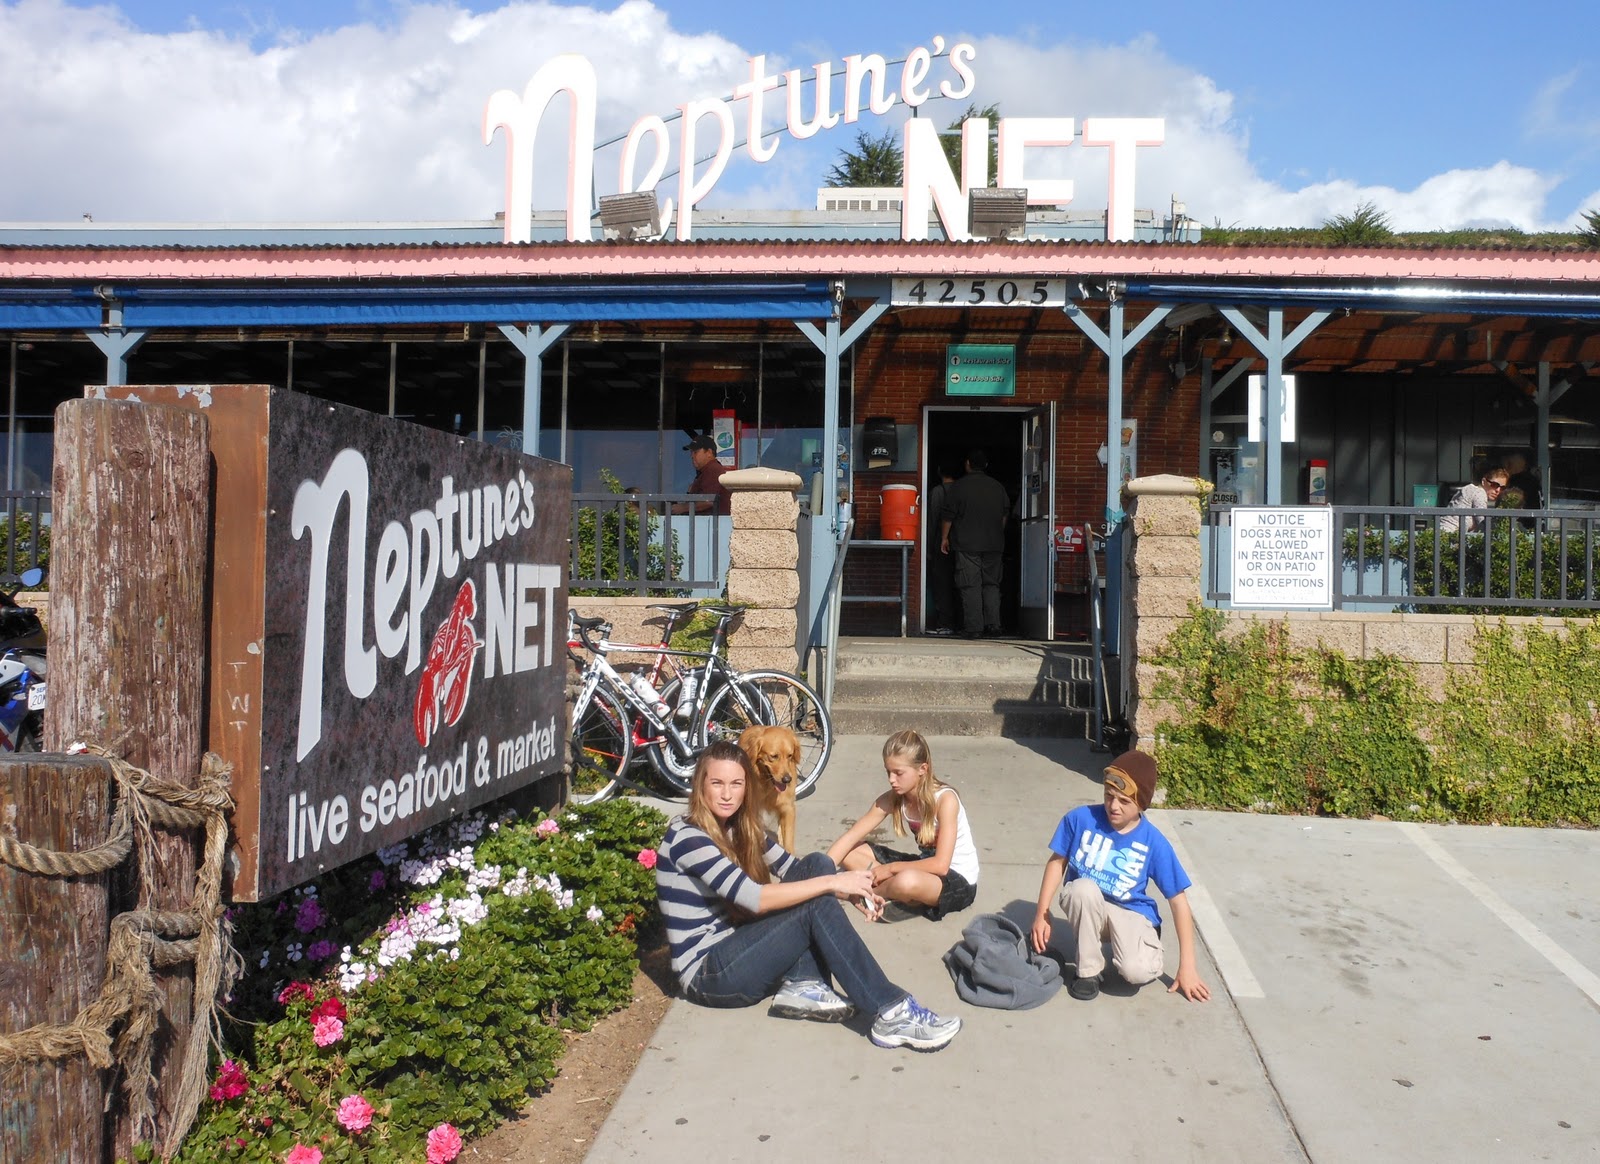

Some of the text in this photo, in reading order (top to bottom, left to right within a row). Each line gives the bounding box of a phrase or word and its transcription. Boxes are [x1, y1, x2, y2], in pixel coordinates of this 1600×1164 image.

[901, 117, 1165, 241] NET
[909, 279, 1048, 305] 42505
[1213, 493, 1238, 504] CLOSED
[1258, 514, 1305, 525] NOTICE
[1240, 529, 1322, 539] DOGS ARE NOT
[1254, 540, 1308, 549] ALLOWED
[1238, 551, 1325, 560] IN RESTAURANT
[1247, 562, 1316, 571] OR ON PATIO
[1239, 578, 1324, 588] NO EXCEPTIONS
[484, 563, 561, 679] NET
[287, 790, 349, 863] live
[359, 741, 468, 833] seafood
[474, 735, 490, 787] &
[496, 715, 556, 779] market
